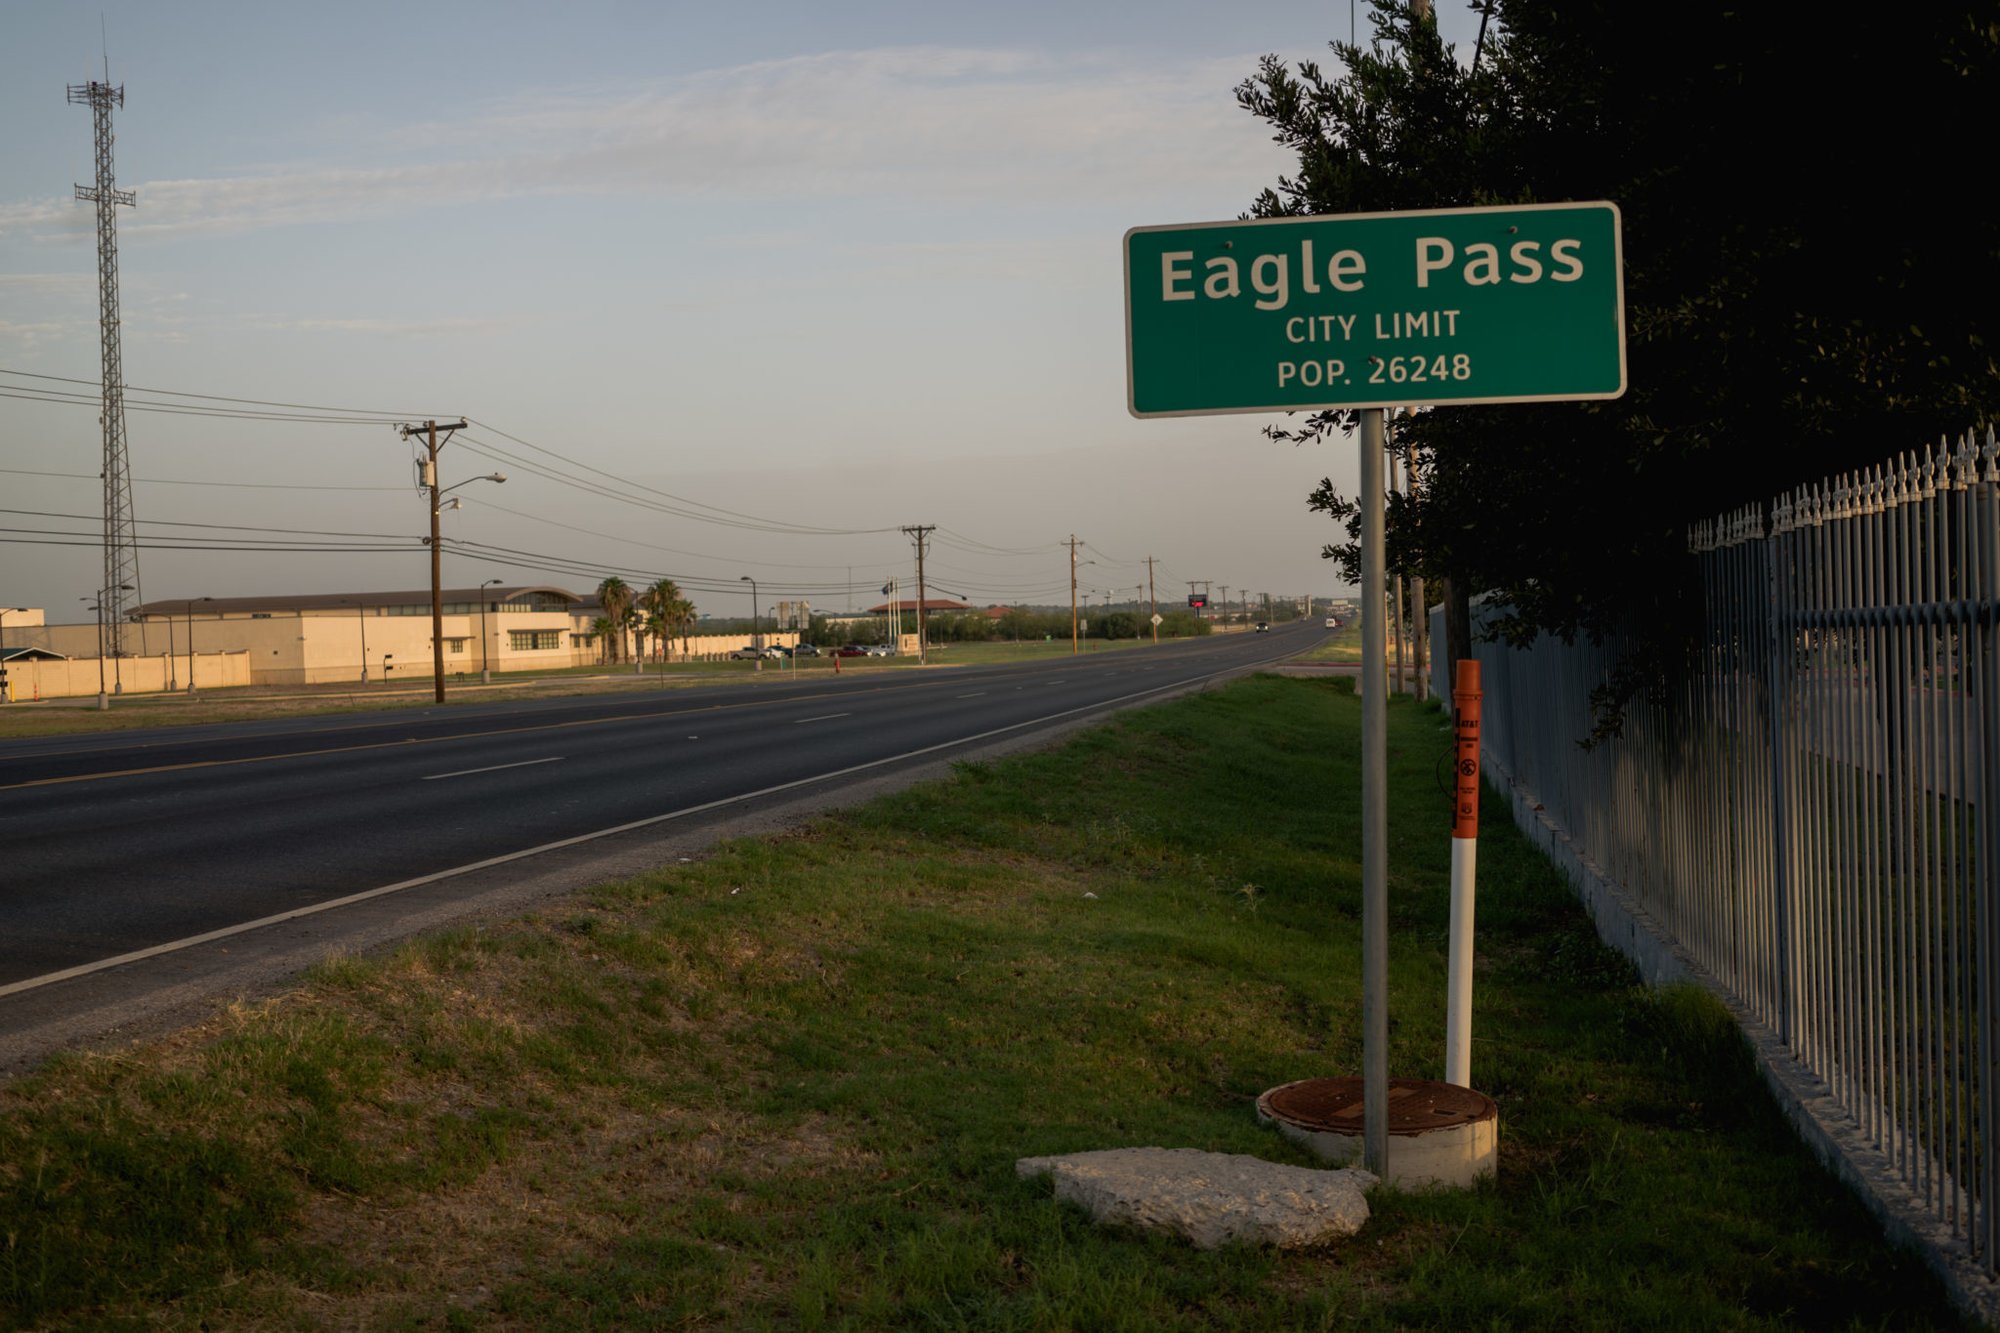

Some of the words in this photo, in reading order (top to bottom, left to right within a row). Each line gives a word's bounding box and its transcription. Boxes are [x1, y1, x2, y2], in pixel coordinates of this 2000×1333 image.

[1161, 239, 1367, 311] Eagle
[1416, 237, 1584, 288] Pass
[1285, 314, 1357, 344] CITY
[1375, 310, 1461, 340] LIMIT
[1278, 360, 1352, 388] POP.
[1369, 353, 1472, 385] 26248
[1461, 720, 1478, 728] AT&T
